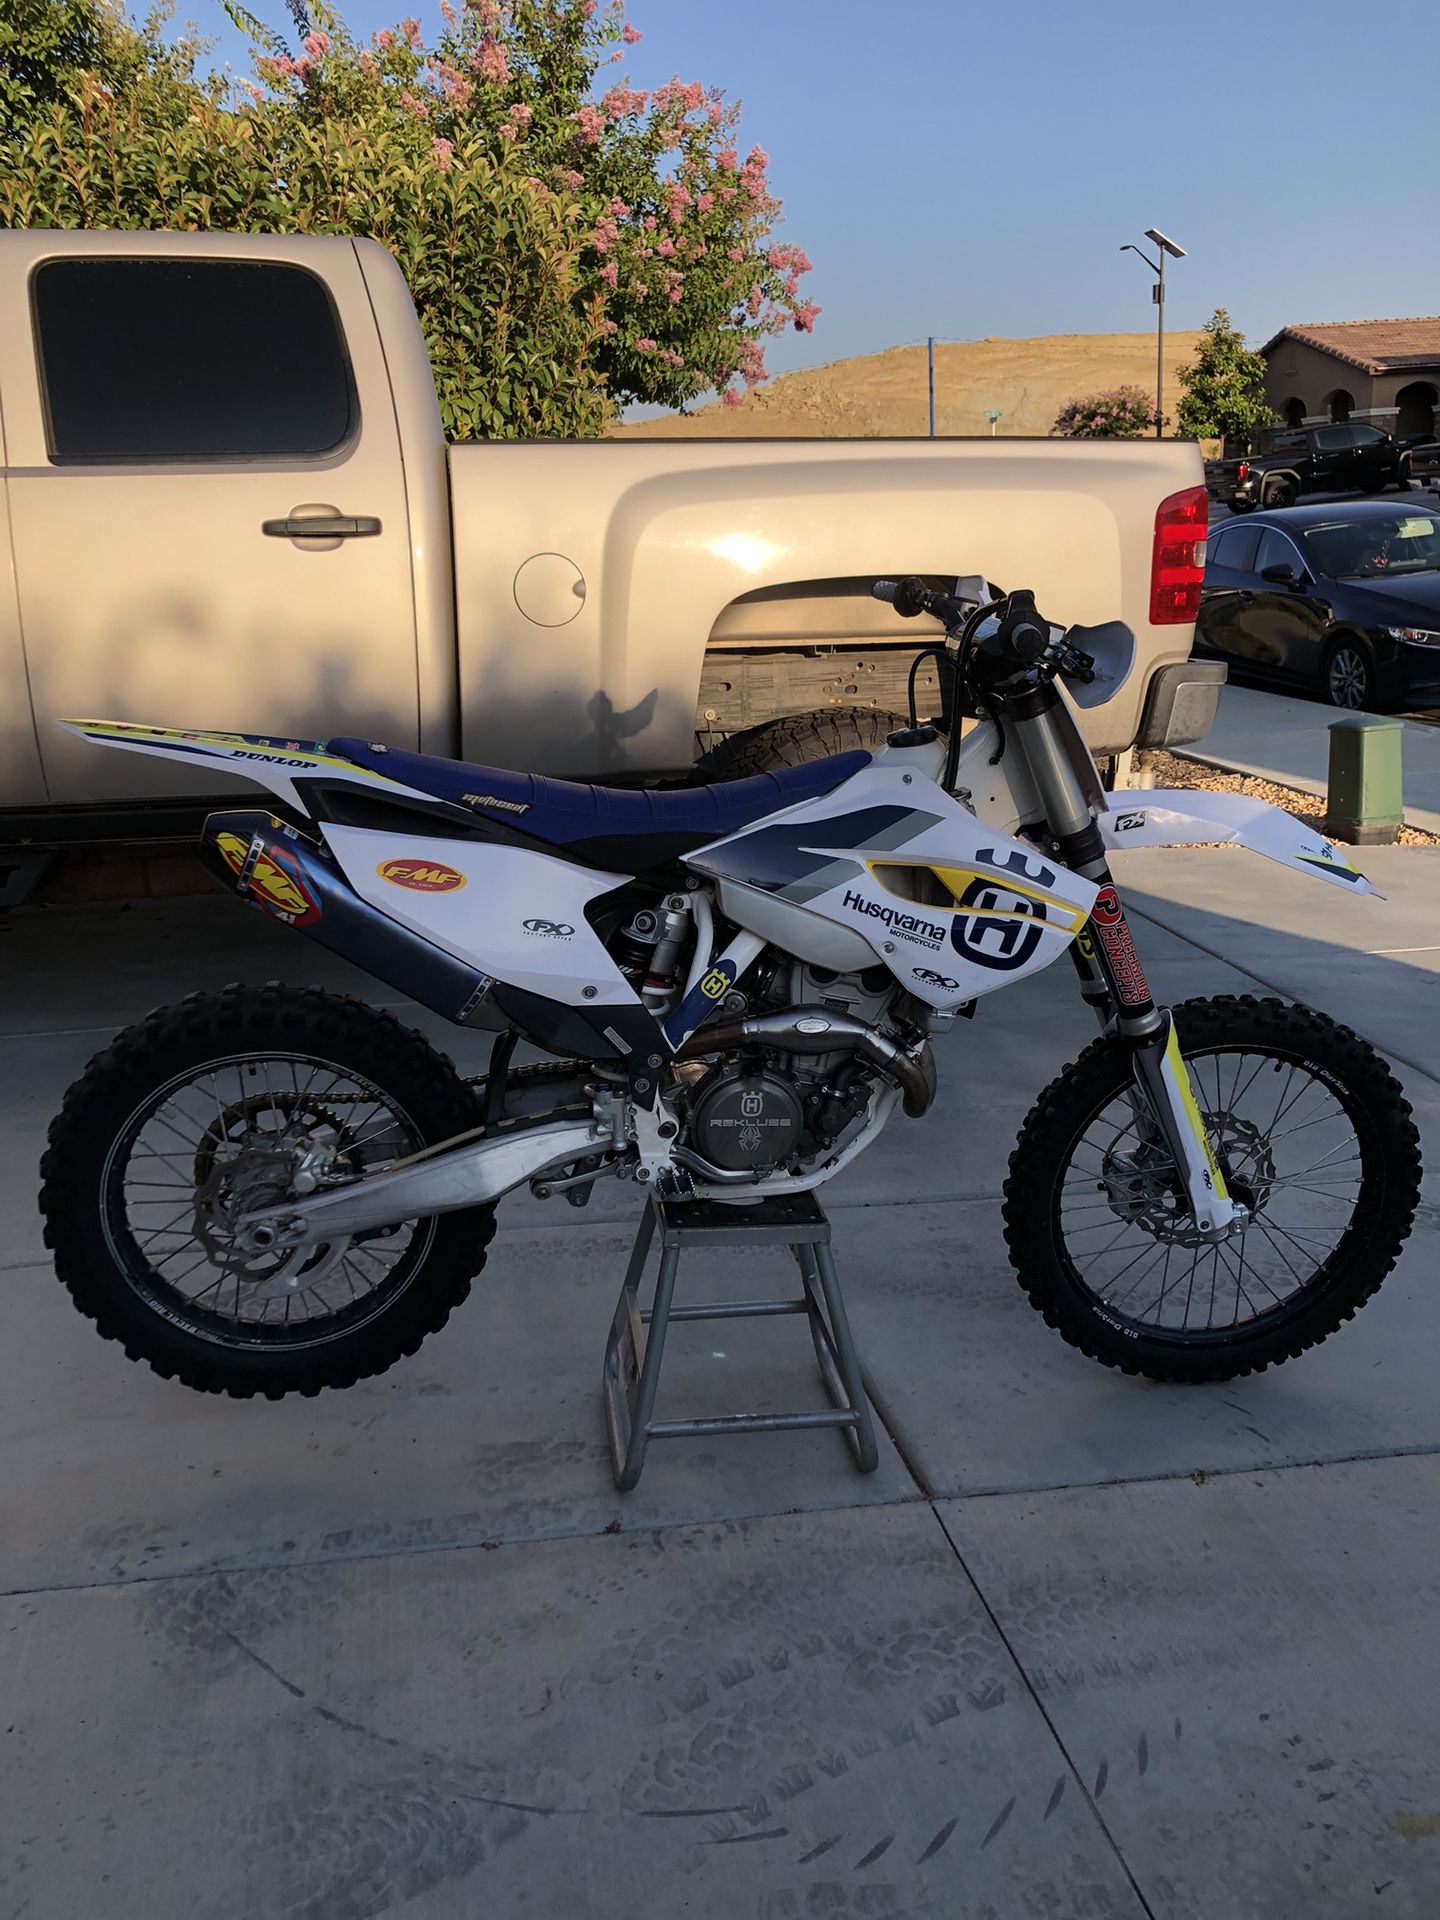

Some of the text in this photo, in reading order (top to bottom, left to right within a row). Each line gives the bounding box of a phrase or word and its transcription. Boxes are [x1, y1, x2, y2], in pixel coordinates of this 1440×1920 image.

[229, 750, 318, 769] DUNLOP
[383, 866, 463, 884] FMF
[842, 889, 946, 942] Husqvarna
[889, 928, 941, 951] MOTORCYCLES
[1100, 926, 1140, 1003] CONCEPTS
[710, 1119, 791, 1127] REKLUSE
